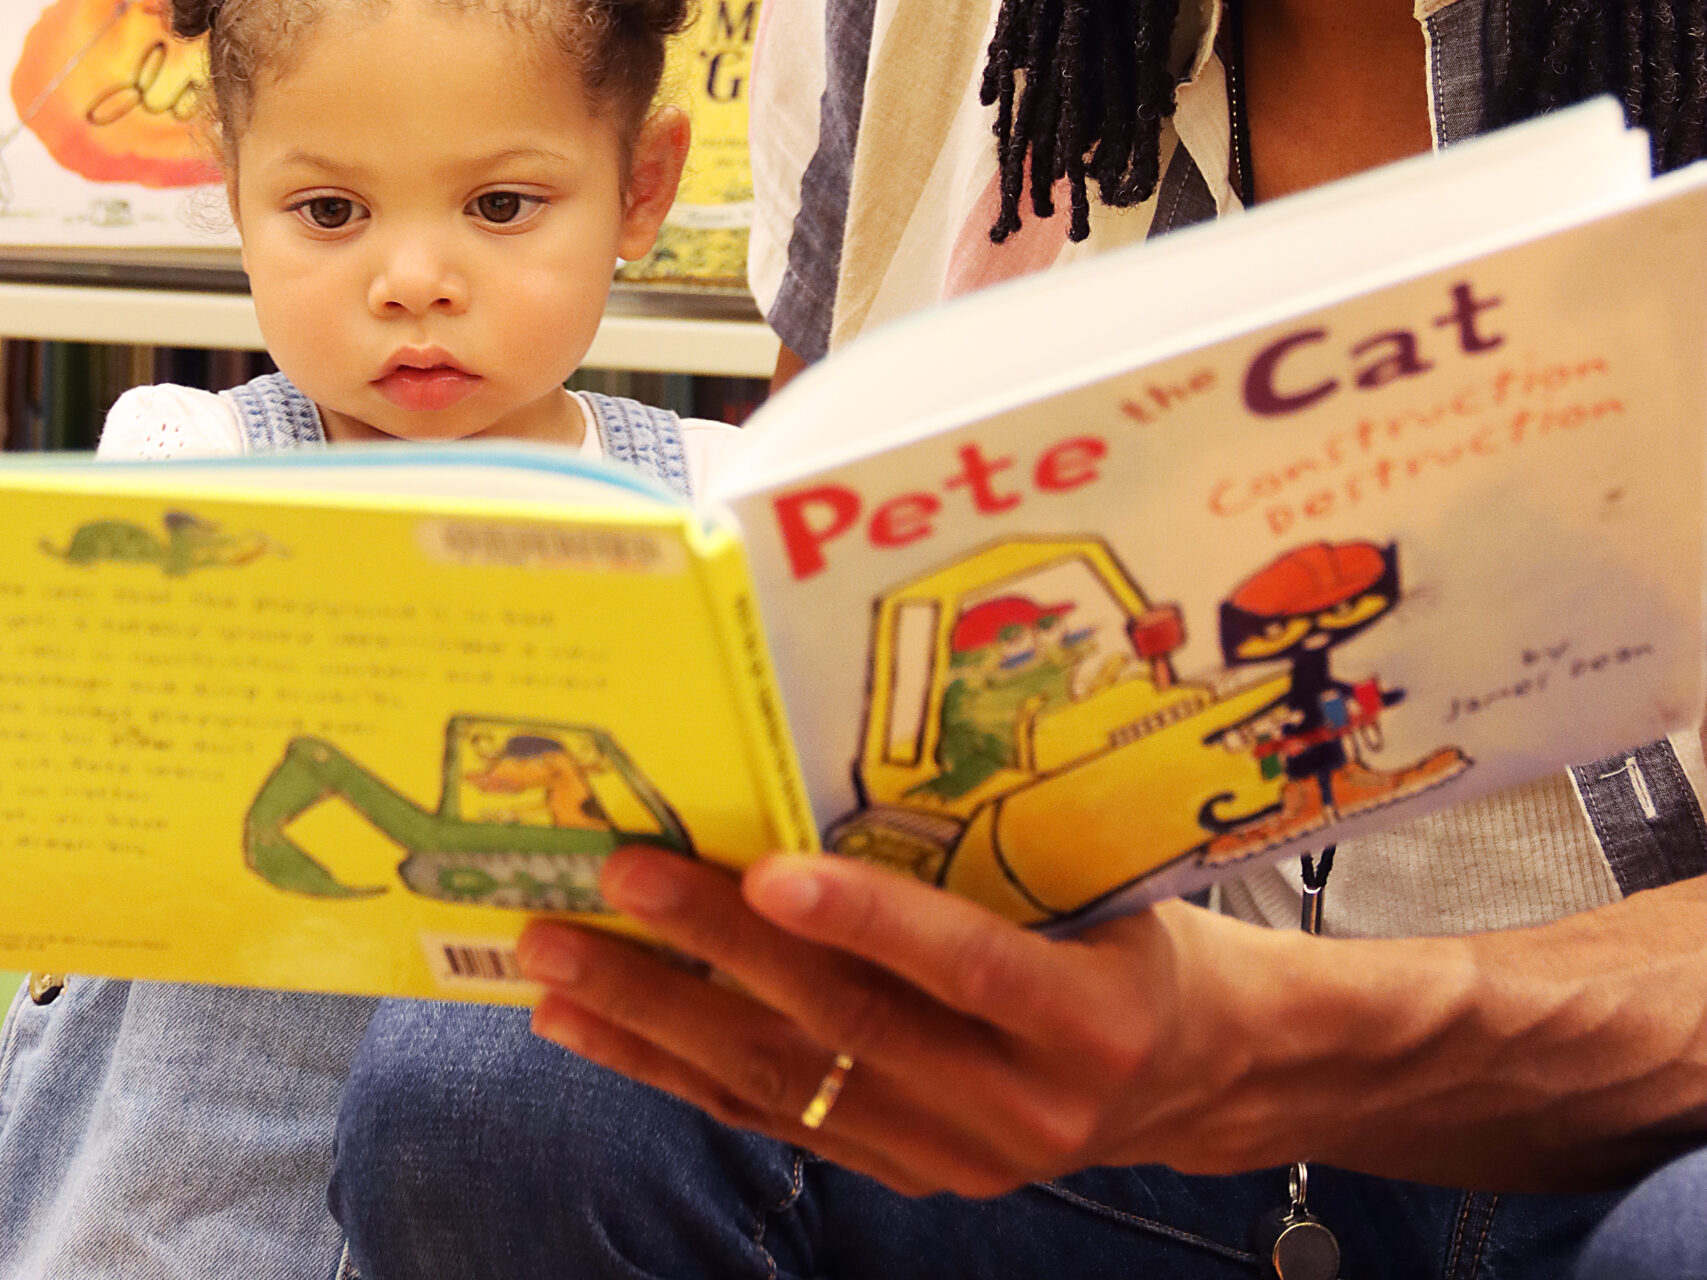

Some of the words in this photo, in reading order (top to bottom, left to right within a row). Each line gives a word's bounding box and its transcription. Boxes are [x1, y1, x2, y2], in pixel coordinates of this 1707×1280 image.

[772, 435, 1110, 582] Pete
[1120, 367, 1220, 426] the
[1240, 280, 1507, 417] Cat
[1207, 354, 1609, 517] Construction
[1264, 398, 1626, 537] Destruction
